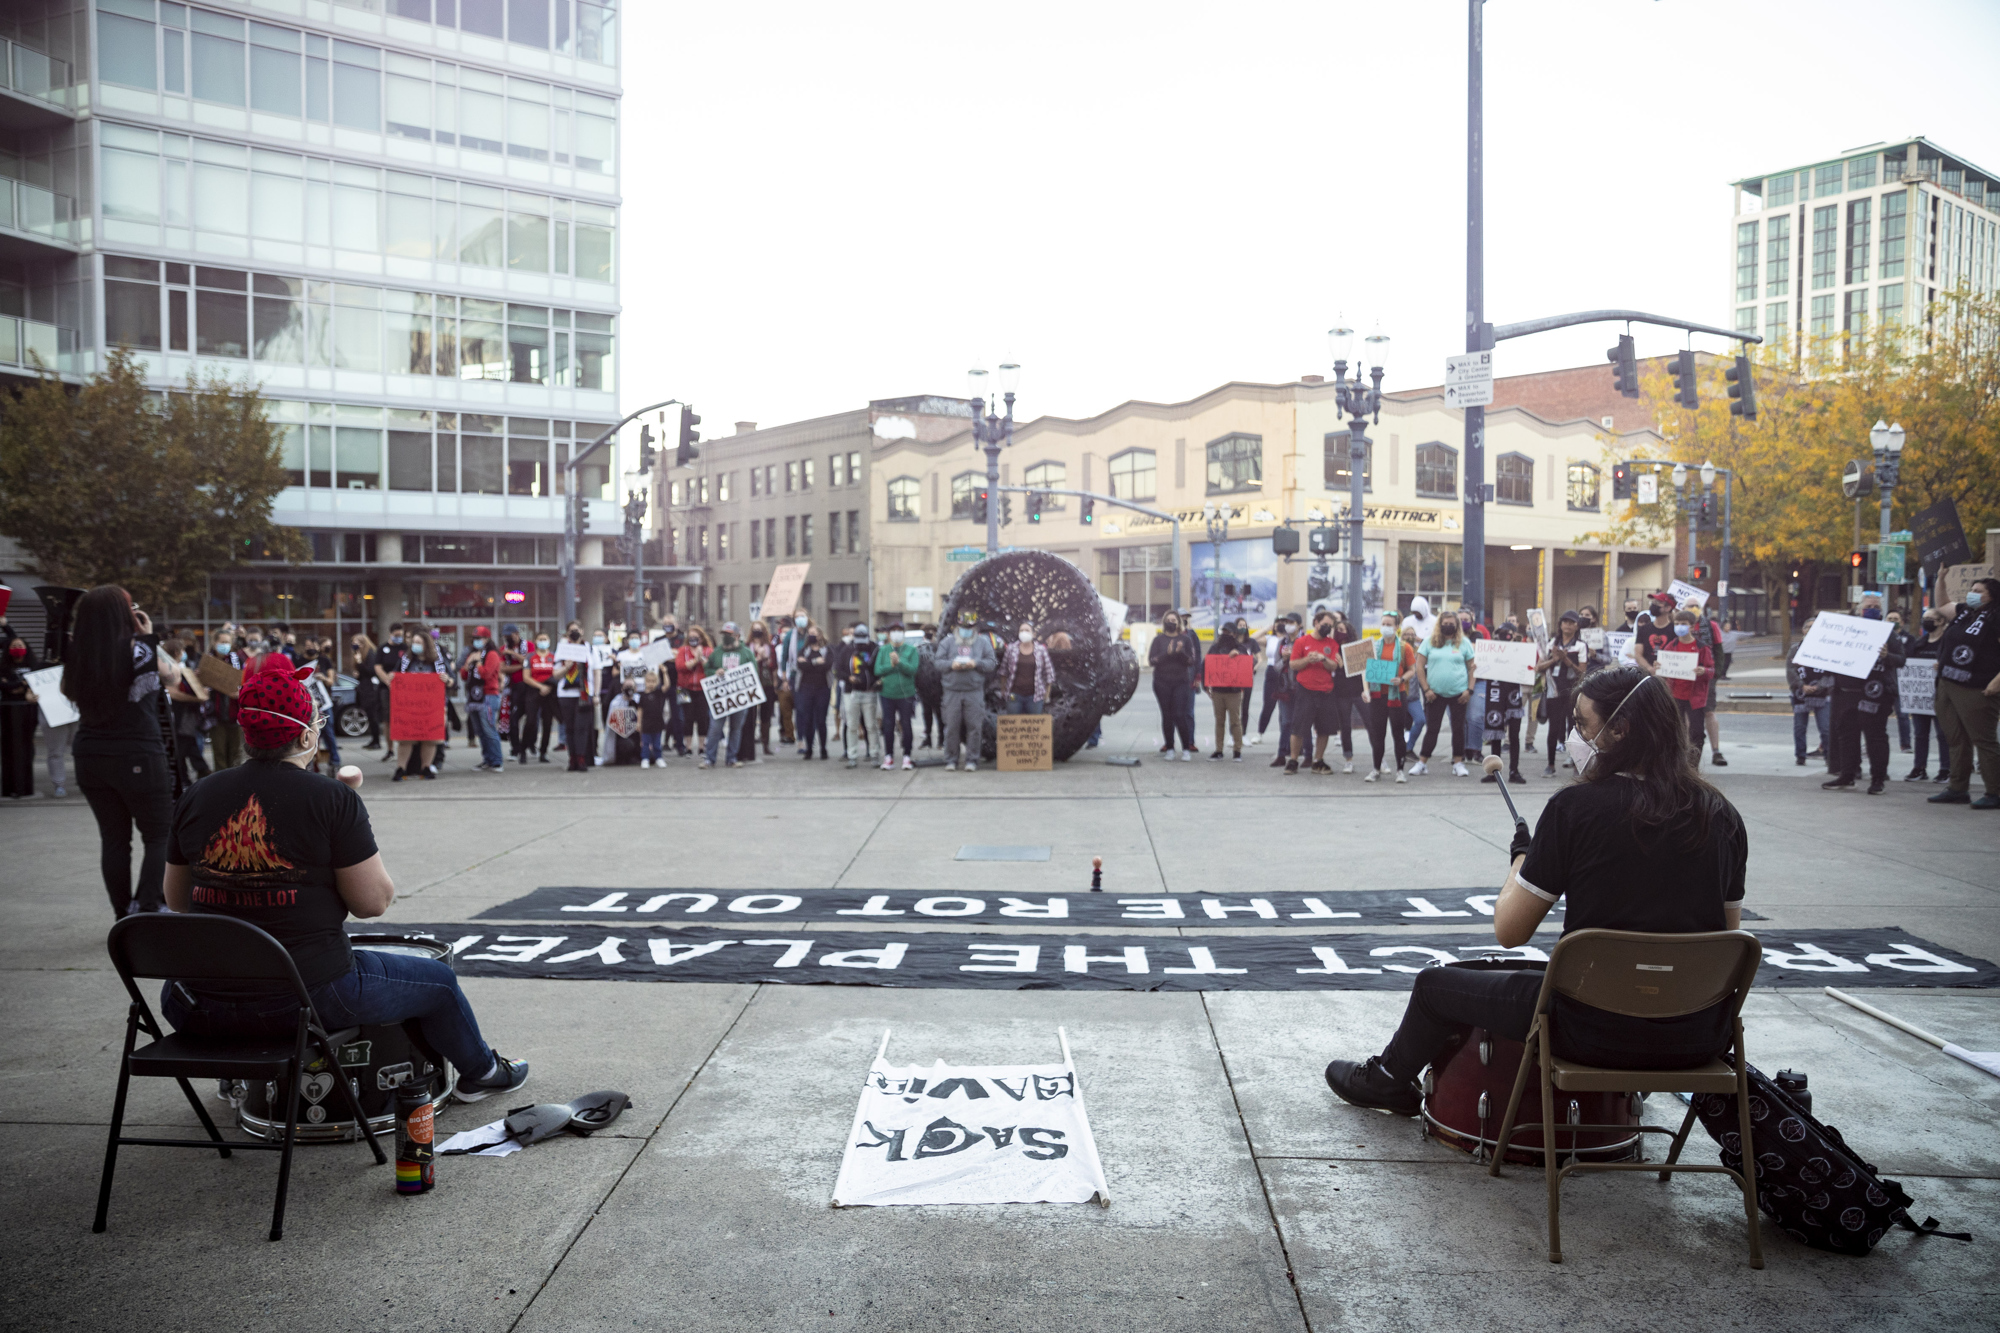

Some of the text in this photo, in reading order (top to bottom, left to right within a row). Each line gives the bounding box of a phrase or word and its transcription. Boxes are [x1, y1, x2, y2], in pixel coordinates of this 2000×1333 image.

[1381, 509, 1438, 523] ATTACK
[505, 592, 525, 602] OPEN
[1477, 641, 1507, 654] BURN
[1845, 640, 1874, 652] BETTER
[1214, 656, 1241, 670] THEY
[1371, 659, 1390, 671] GW
[728, 666, 752, 679] YOUR
[1366, 668, 1393, 682] OUT
[708, 674, 757, 701] POWER
[713, 688, 762, 715] BACK
[1001, 726, 1040, 734] WOMEN
[1028, 741, 1043, 749] YOU
[1006, 749, 1047, 757] PROTECTED
[192, 886, 298, 906] BURN THE LOT
[560, 891, 803, 914] OUT
[836, 895, 1070, 919] ROT
[1115, 897, 1362, 920] THE
[452, 935, 1979, 975] PRECT THE PLAYE
[414, 1126, 433, 1135] CANNO
[419, 1120, 432, 1128] AND
